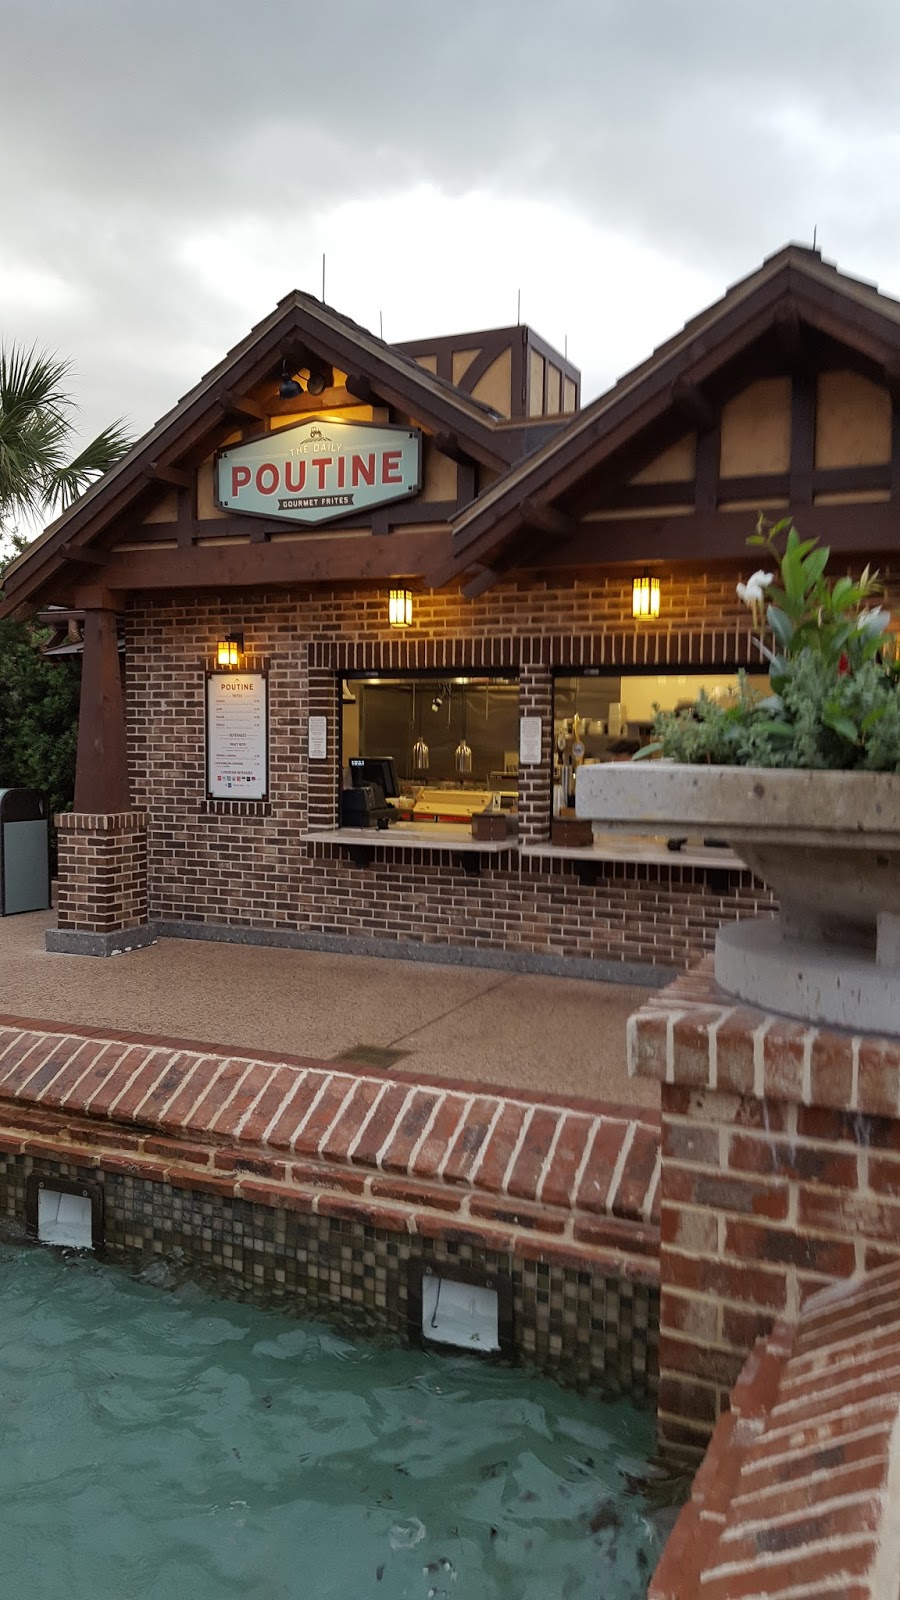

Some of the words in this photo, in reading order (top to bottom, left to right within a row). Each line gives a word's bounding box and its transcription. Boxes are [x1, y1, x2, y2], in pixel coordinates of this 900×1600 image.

[290, 444, 309, 457] THE
[313, 443, 343, 453] DAILY
[231, 450, 403, 497] POUTINE
[282, 499, 319, 509] GOURMET
[321, 496, 349, 505] FRITES
[221, 683, 254, 691] POUTINE
